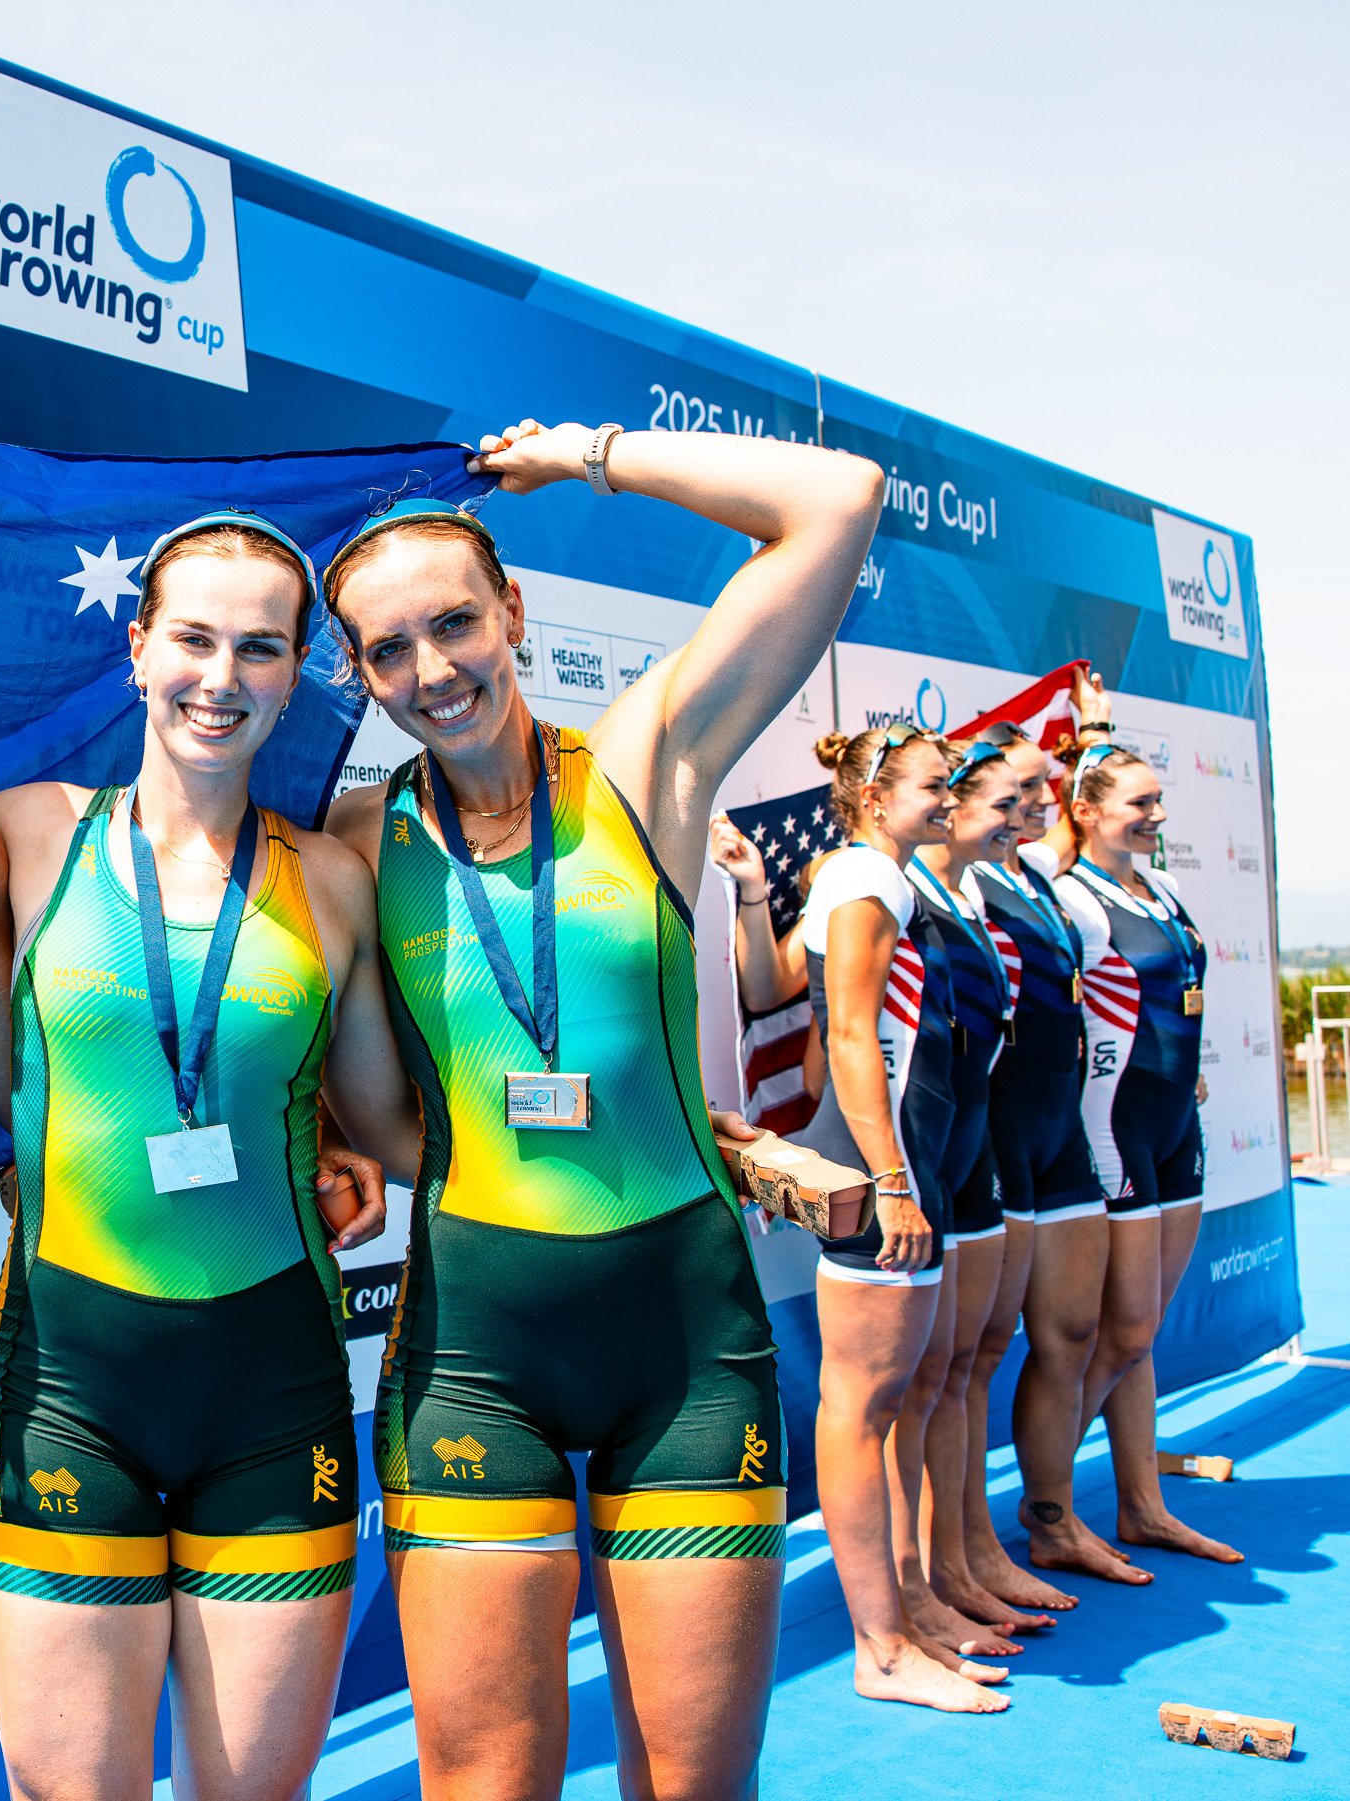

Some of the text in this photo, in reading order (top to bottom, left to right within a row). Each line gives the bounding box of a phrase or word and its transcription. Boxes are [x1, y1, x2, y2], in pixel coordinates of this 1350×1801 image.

[0, 247, 225, 355] rowing cup
[939, 481, 987, 545] Cup
[1168, 577, 1205, 605] world
[551, 648, 603, 672] HEALTHY
[556, 668, 605, 691] WATERS
[403, 926, 458, 951] HANCOCK
[403, 934, 480, 961] PROSPECTIN
[53, 967, 118, 983] HANCOCK
[1091, 1040, 1117, 1080] USA
[442, 1463, 486, 1480] AIS
[38, 1496, 79, 1514] AIS
